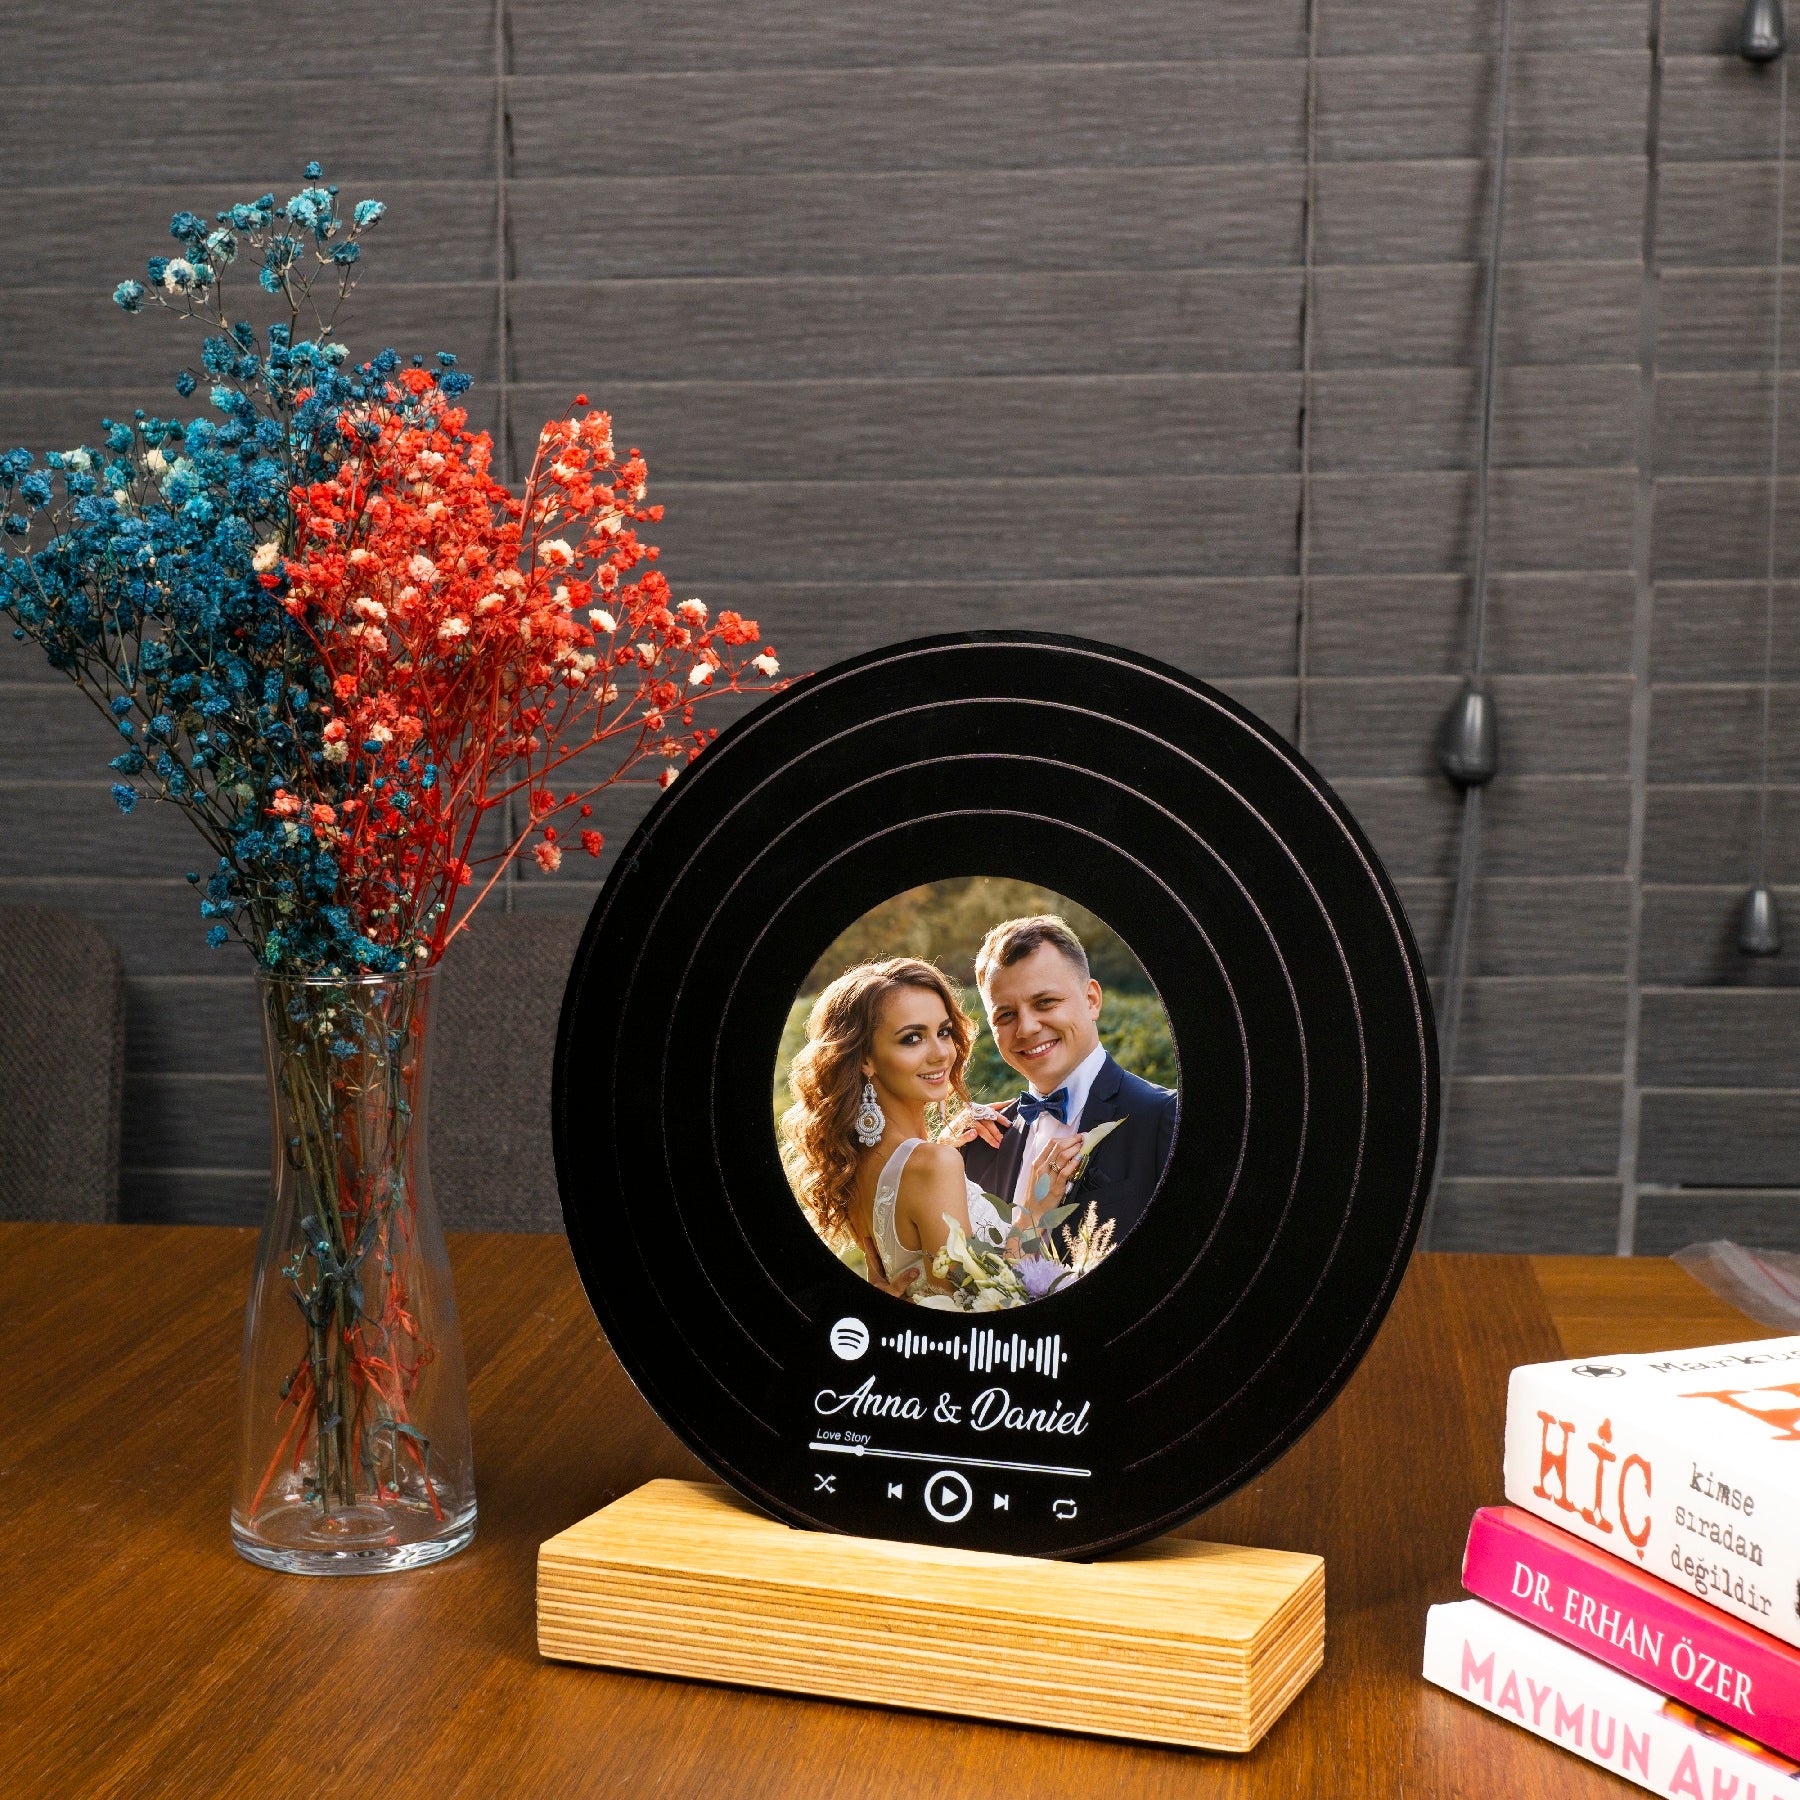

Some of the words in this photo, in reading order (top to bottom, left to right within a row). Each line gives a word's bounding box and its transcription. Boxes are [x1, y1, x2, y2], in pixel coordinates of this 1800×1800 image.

[814, 1374, 927, 1418] Anna
[933, 1392, 962, 1424] &
[970, 1387, 1091, 1436] Daniel
[816, 1428, 842, 1441] Love
[844, 1430, 872, 1445] Story
[1689, 1462, 1755, 1517] kimse
[1675, 1505, 1764, 1567] sıradan
[1670, 1543, 1772, 1616] değildir
[1510, 1561, 1554, 1613] DR.
[1563, 1586, 1663, 1667] ERHAN
[1670, 1637, 1756, 1716] ÖZER
[1460, 1639, 1651, 1781] MAYMUN
[1668, 1743, 1788, 1800] AK
